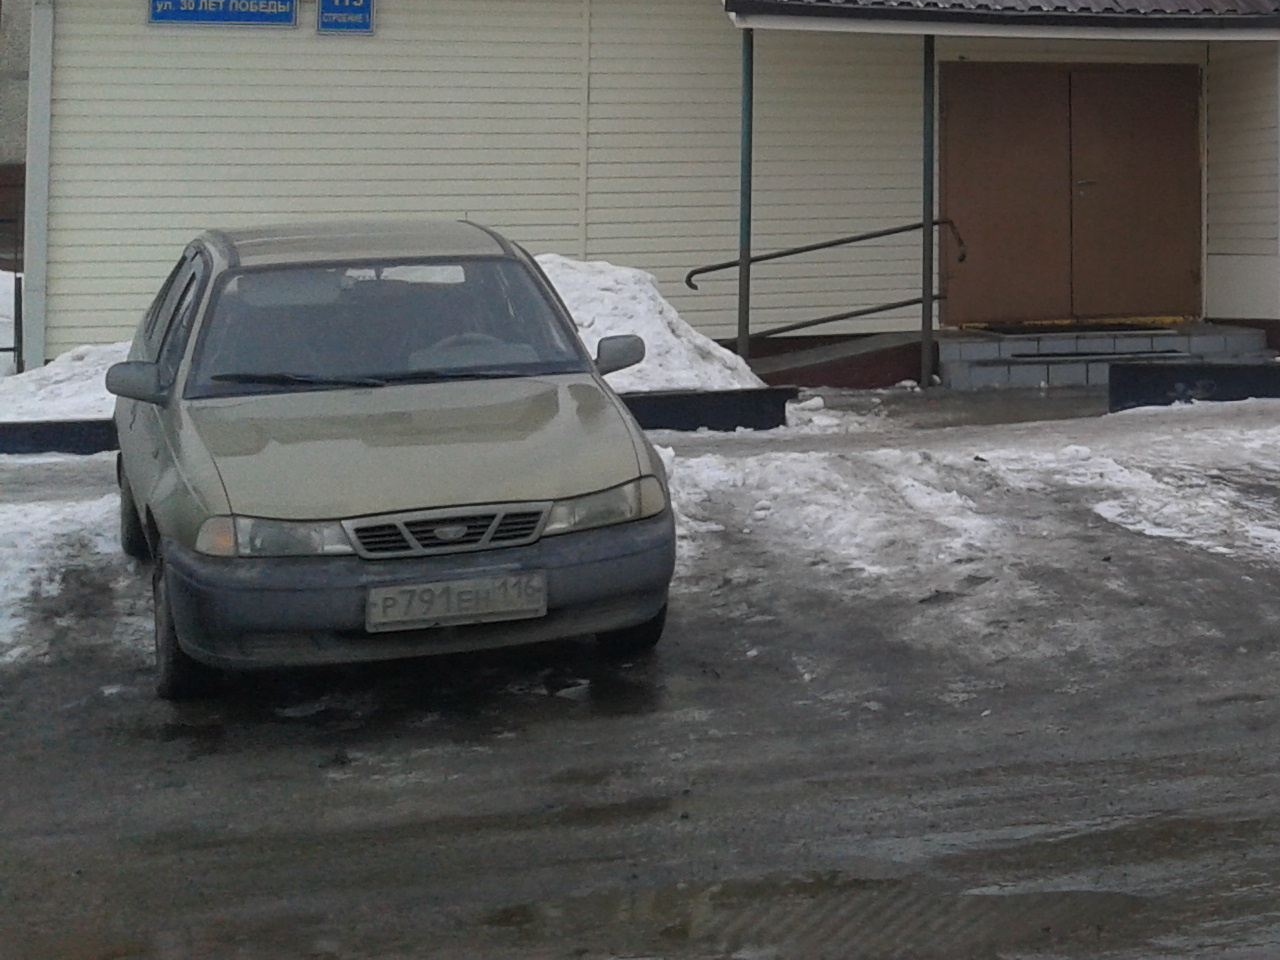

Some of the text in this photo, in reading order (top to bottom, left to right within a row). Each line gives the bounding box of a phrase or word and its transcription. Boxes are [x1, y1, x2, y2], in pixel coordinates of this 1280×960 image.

[180, 0, 195, 11] 30
[198, 0, 225, 11] ЛЕТ
[229, 0, 291, 14] ПОБЕДЫ
